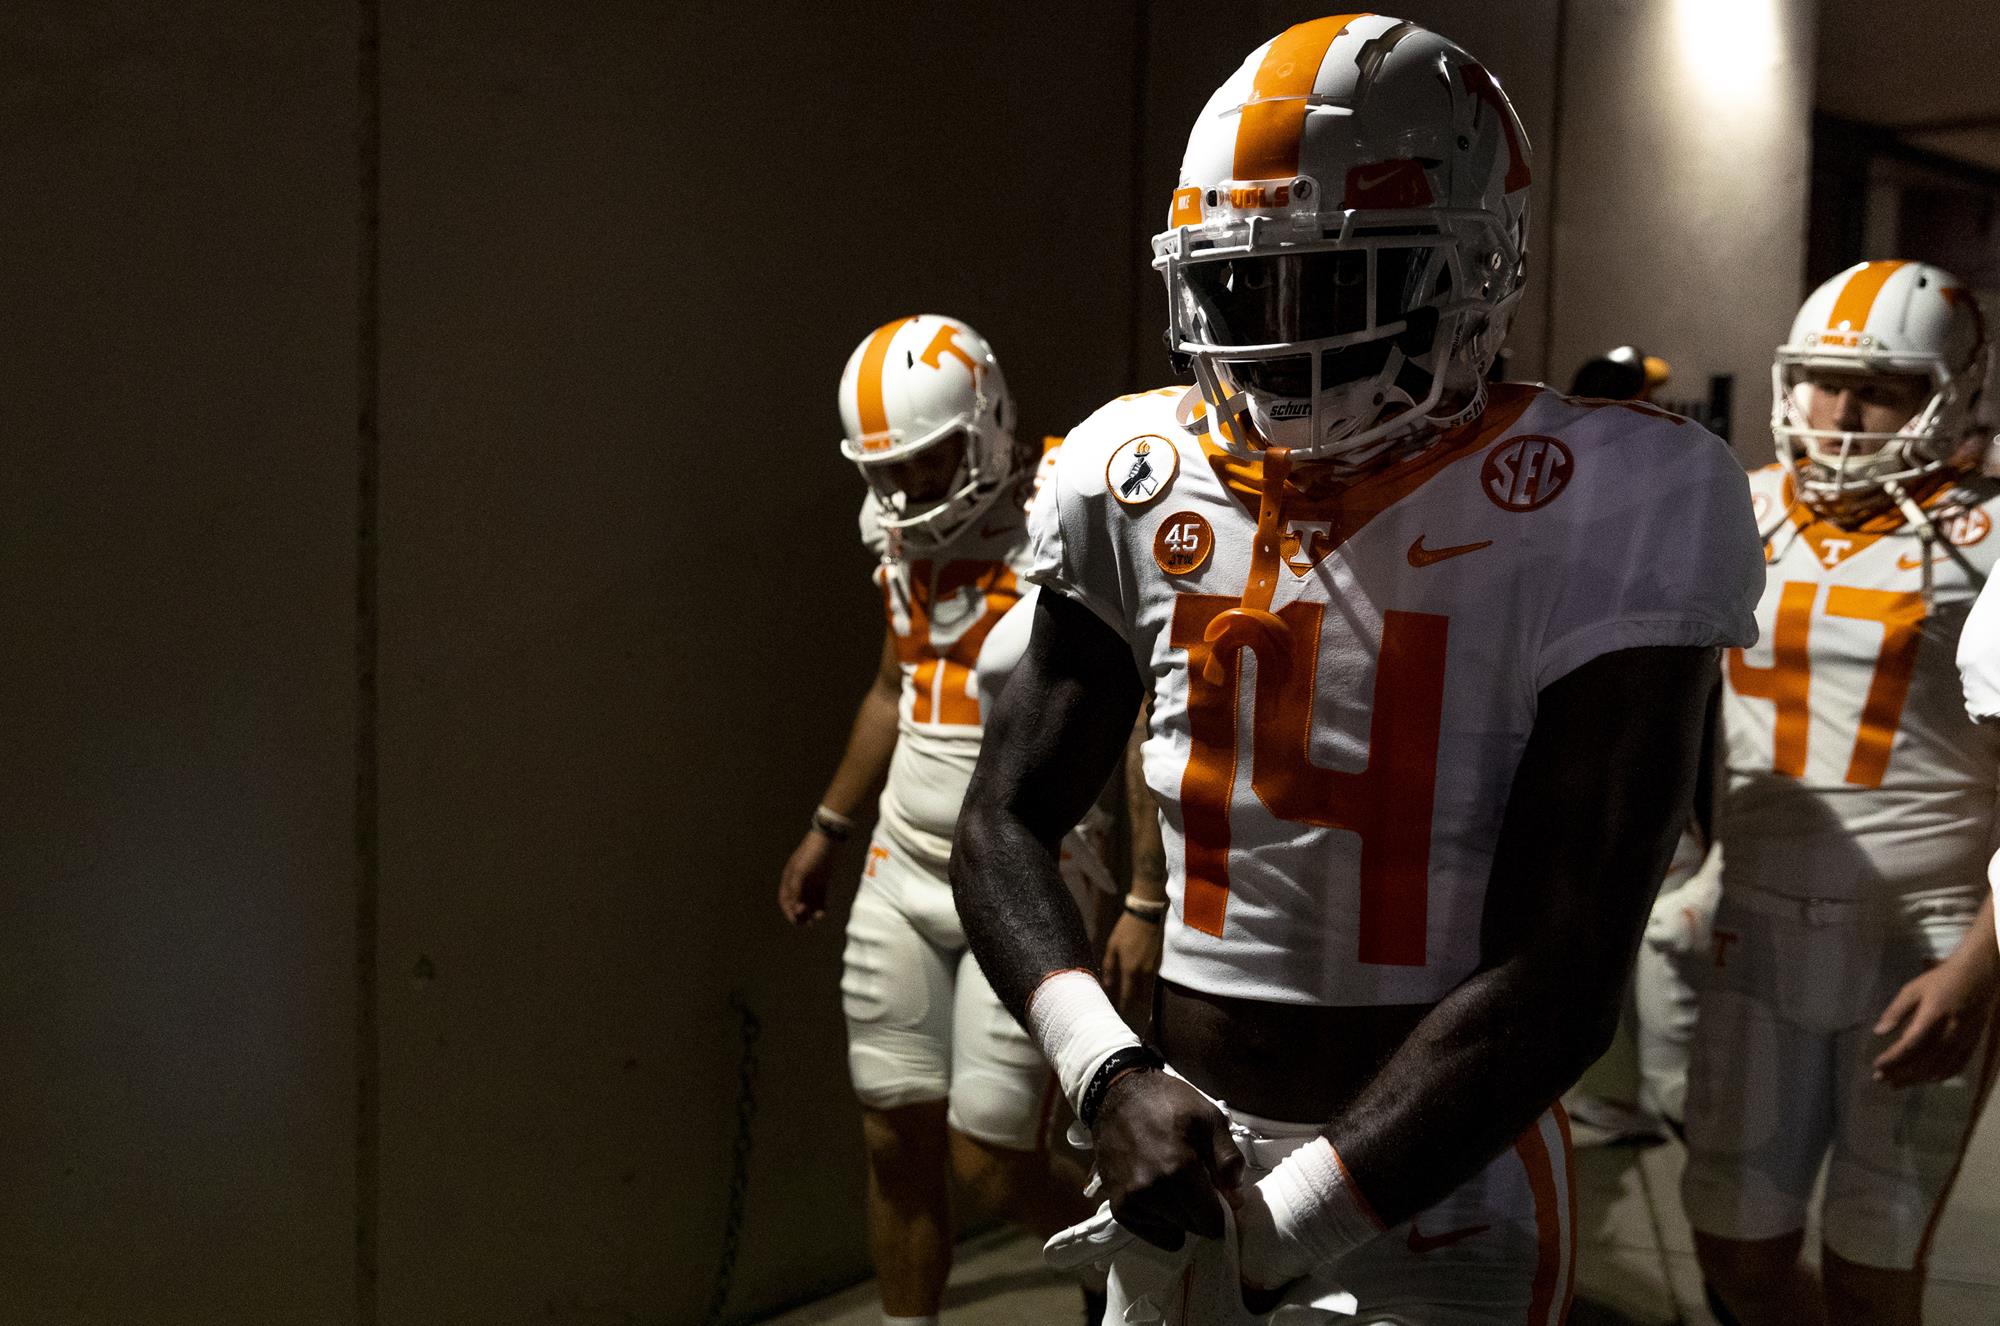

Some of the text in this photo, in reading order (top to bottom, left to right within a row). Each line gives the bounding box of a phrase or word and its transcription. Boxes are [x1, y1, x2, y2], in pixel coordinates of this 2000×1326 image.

[920, 324, 989, 392] T
[1490, 440, 1567, 504] SEC
[1164, 523, 1200, 552] 45
[1286, 520, 1332, 564] T
[1820, 538, 1852, 564] T
[1728, 580, 1928, 788] 47
[1170, 594, 1449, 966] 14
